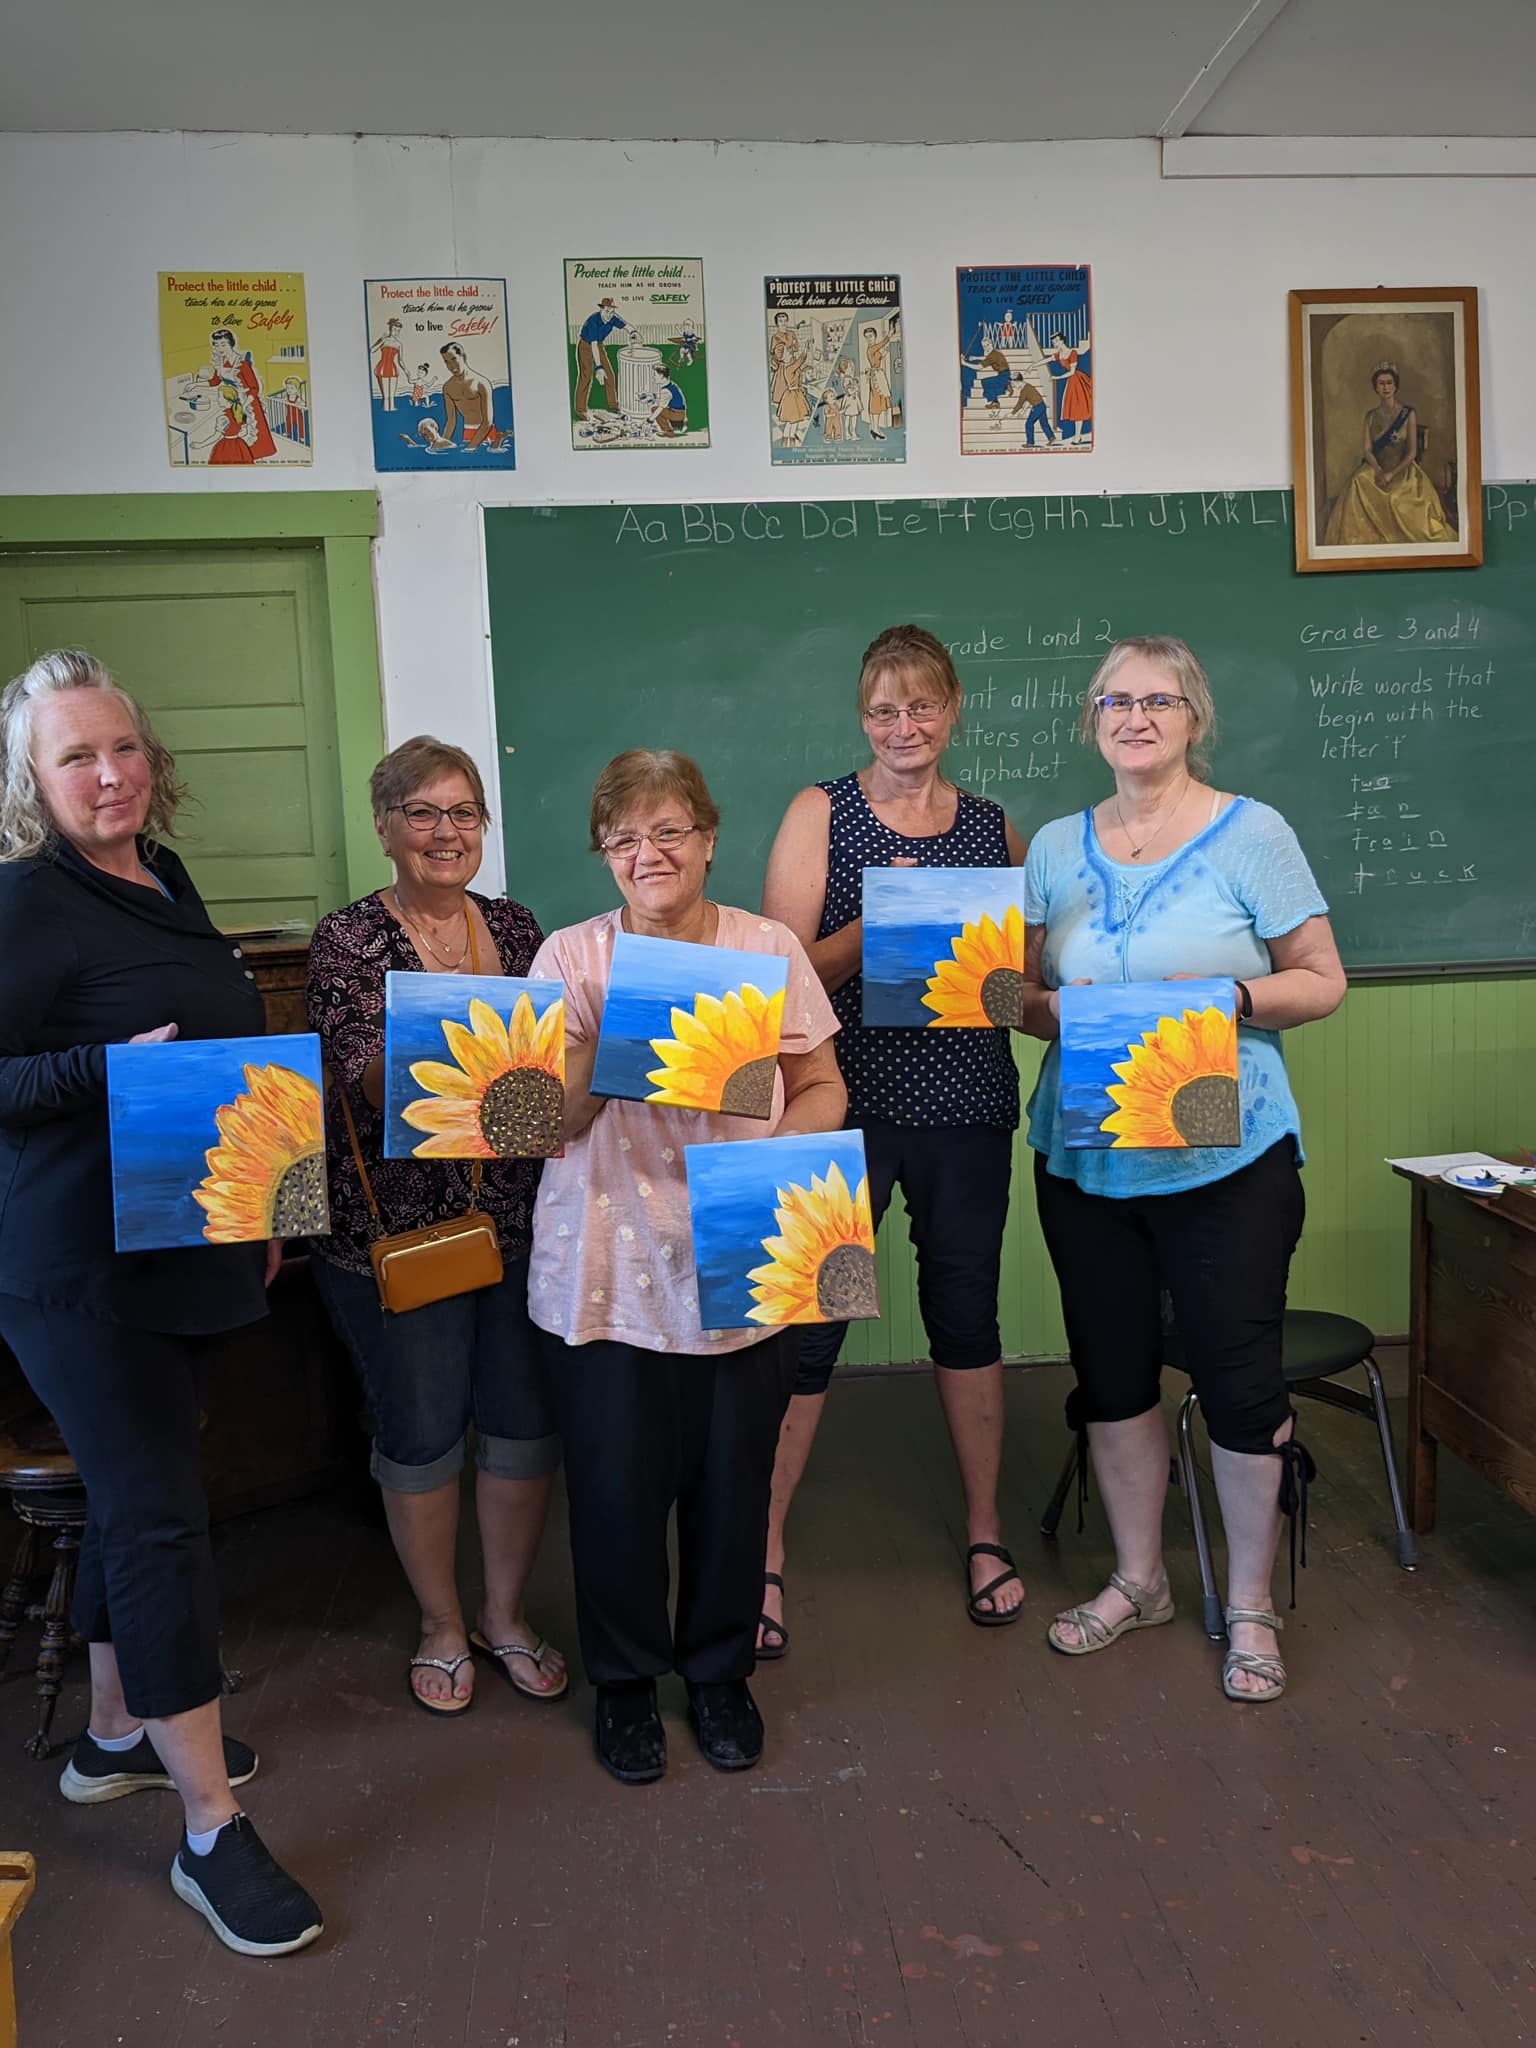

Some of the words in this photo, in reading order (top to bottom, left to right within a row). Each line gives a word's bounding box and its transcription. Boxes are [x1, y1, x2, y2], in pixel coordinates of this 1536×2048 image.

[574, 263, 610, 279] Protect
[613, 265, 629, 278] the
[631, 264, 655, 278] little
[960, 272, 1000, 282] PROTECT
[1005, 271, 1020, 281] THE
[1027, 271, 1055, 281] LITTLE
[1059, 271, 1086, 281] CHILD
[168, 277, 205, 292] Protect
[208, 279, 223, 291] the
[226, 279, 249, 291] little
[380, 285, 413, 299] Protect
[417, 286, 431, 298] the
[433, 286, 455, 297] little
[769, 281, 811, 294] PROTECT
[814, 281, 832, 293] THE
[835, 281, 865, 293] LITTLE
[868, 280, 896, 292] CHILD
[967, 285, 996, 294] TEACH
[184, 297, 208, 307] teach
[253, 299, 278, 311] grows
[649, 294, 690, 302] SAFELY
[775, 294, 803, 306] Teach
[806, 294, 826, 306] him
[841, 294, 855, 305] he
[855, 294, 890, 304] Grows
[982, 296, 992, 304] TO
[996, 296, 1014, 304] LIVE
[1016, 294, 1056, 306] SAFELY
[401, 303, 425, 314] teach
[427, 303, 445, 313] him
[446, 303, 456, 312] as
[457, 302, 468, 312] he
[467, 304, 493, 316] grows
[211, 315, 220, 326] to
[222, 313, 243, 326] live
[247, 309, 295, 330] Safely
[415, 322, 424, 332] to
[427, 320, 444, 332] live
[448, 316, 499, 336] Safely!
[616, 507, 668, 544] Aa
[681, 503, 735, 544] Bb
[741, 503, 785, 540] Cc
[800, 501, 858, 540] Dd
[874, 500, 927, 537] Ee
[988, 497, 1034, 540] Gg
[1045, 496, 1089, 530] Hh
[1149, 494, 1187, 535] Jj
[1201, 491, 1241, 526] Kk
[1487, 485, 1527, 531] Pp
[943, 625, 1010, 656] rade
[1026, 624, 1033, 645] 1
[1042, 618, 1081, 646] and
[1095, 619, 1118, 644] 2
[1300, 617, 1384, 644] Grade
[1397, 618, 1417, 639] 3
[1425, 612, 1460, 640] and
[1468, 617, 1480, 640] 4
[1310, 667, 1366, 697] Write
[1375, 667, 1433, 695] words
[1445, 660, 1496, 689] that
[962, 675, 998, 710] int
[1011, 677, 1039, 710] all
[1048, 675, 1086, 709] the
[1318, 703, 1375, 739] begin
[1386, 699, 1434, 723] with
[1446, 698, 1484, 719] the
[1032, 717, 1063, 745] of
[1321, 737, 1379, 760] letter
[959, 752, 1068, 795] alphabet
